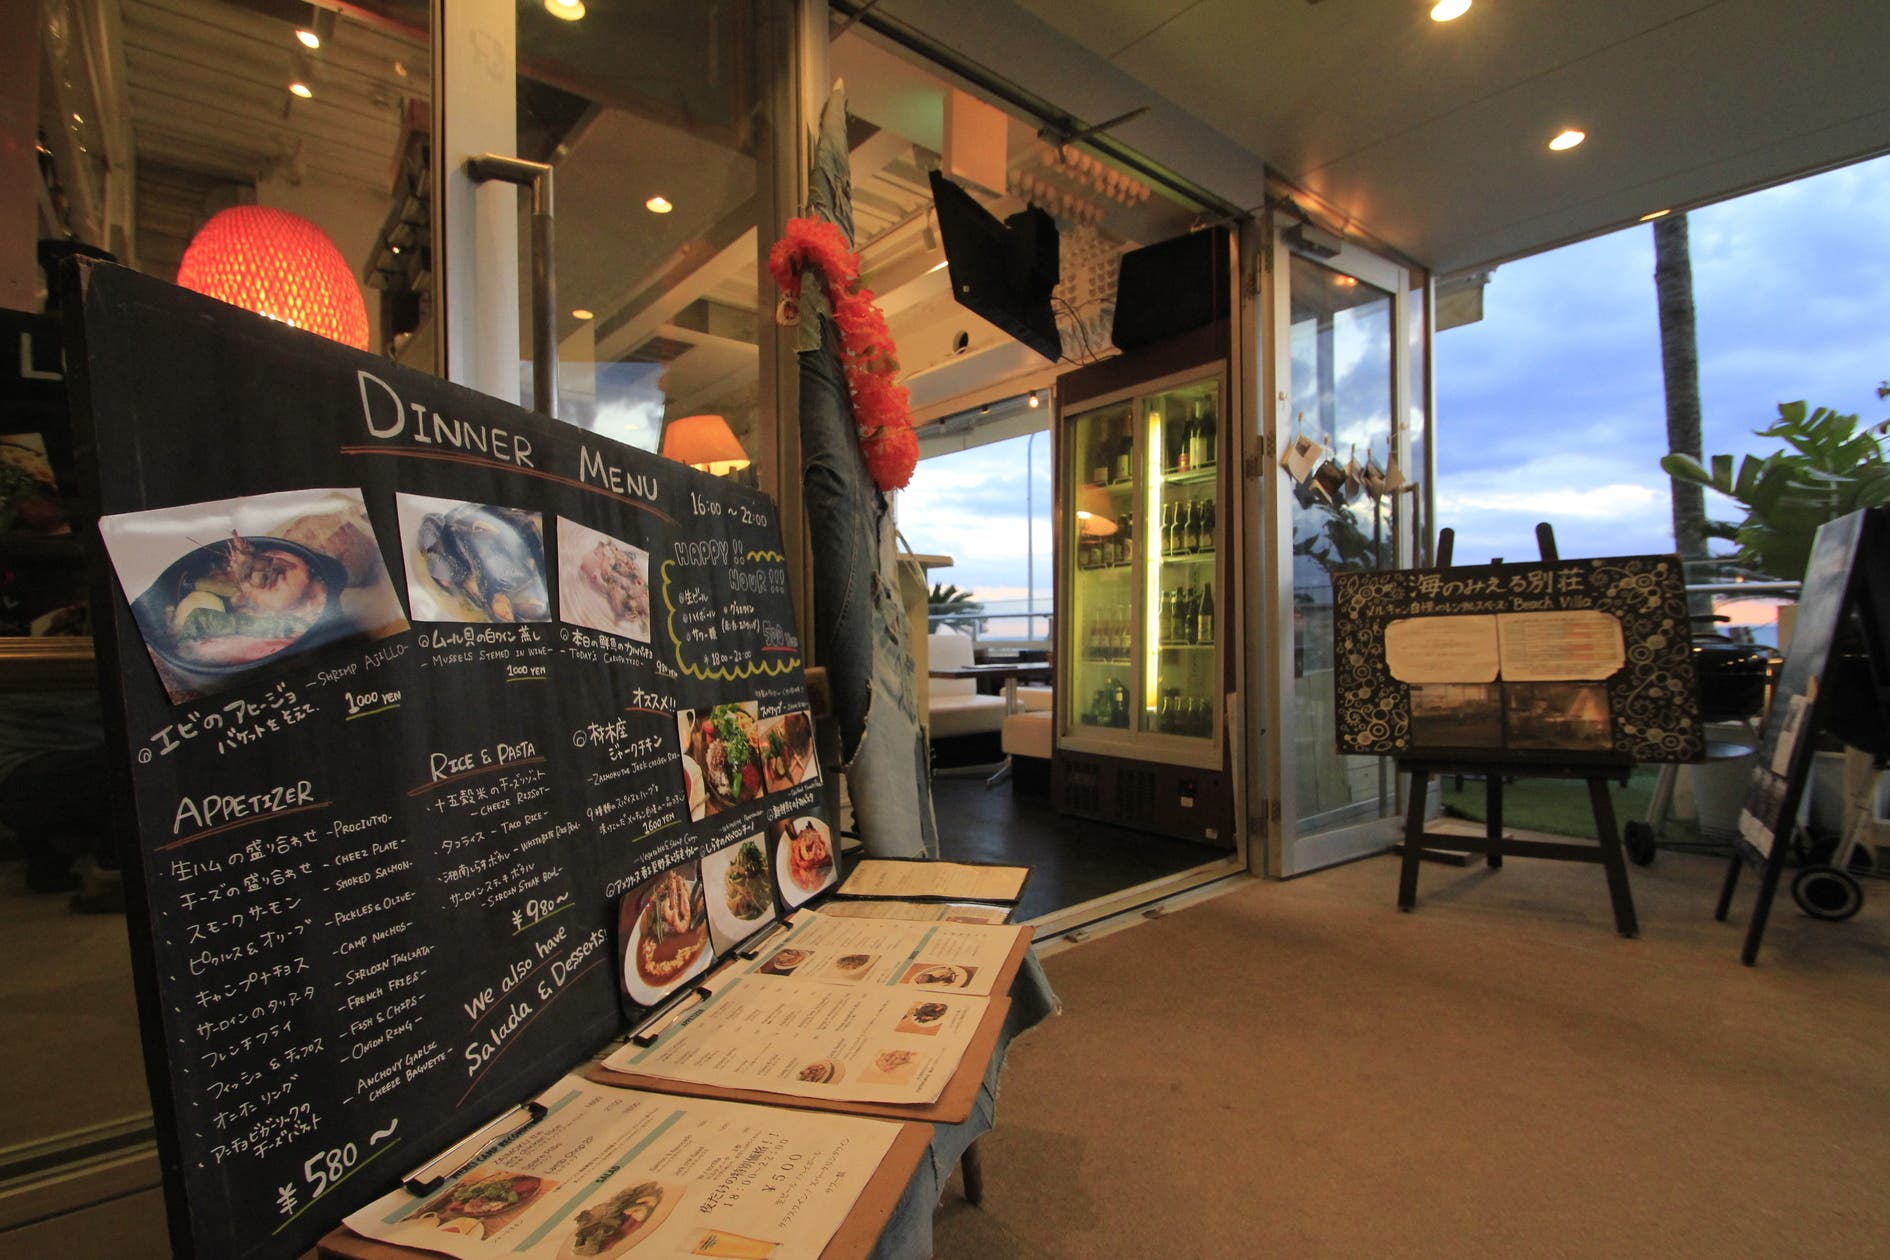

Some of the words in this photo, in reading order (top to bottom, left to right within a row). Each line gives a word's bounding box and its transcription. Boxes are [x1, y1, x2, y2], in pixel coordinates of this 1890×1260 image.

[358, 370, 535, 468] DINNER
[579, 445, 658, 501] MENU
[691, 491, 721, 516] 16:00
[741, 506, 767, 527] 22:00
[674, 539, 728, 566] HAPPY
[728, 568, 767, 594] HOUR
[1409, 567, 1585, 599] 海のみえる別荘
[318, 663, 357, 686] SHRIMP
[507, 665, 528, 676] 1000
[530, 666, 546, 676] YEN
[345, 691, 378, 714] 1000
[381, 690, 401, 705] YEN
[151, 682, 297, 756] エビのアヒージョ
[588, 716, 628, 746] 材木座
[430, 753, 474, 782] RICE
[481, 749, 492, 764] &
[497, 741, 535, 765] PASTA
[609, 735, 662, 761] ジャークチキン
[173, 780, 314, 834] APPETIZER
[501, 821, 521, 834] TACO
[525, 812, 542, 826] RICE
[172, 829, 317, 882] 生ハムの盛り合わせ
[372, 840, 399, 855] PLATE
[442, 832, 485, 854] タコライス
[180, 862, 313, 910] チーズの盛り合わせ
[336, 872, 371, 891] SMOKED
[186, 898, 302, 944] スモークサーモン
[335, 904, 373, 926] PICKLES
[340, 936, 367, 955] CAMP
[346, 959, 389, 985] SIRLOIN
[502, 959, 532, 992] also
[536, 927, 566, 958] have
[196, 957, 310, 1007] キャンプナチョス
[538, 981, 552, 1000] &
[347, 987, 383, 1010] FRENCH
[350, 1017, 373, 1035] FISH
[201, 1020, 291, 1068] フレンチフライ
[357, 1058, 402, 1094] ANCHOVY
[405, 1041, 437, 1066] GARLIC
[213, 1074, 299, 1129] オニオンリング
